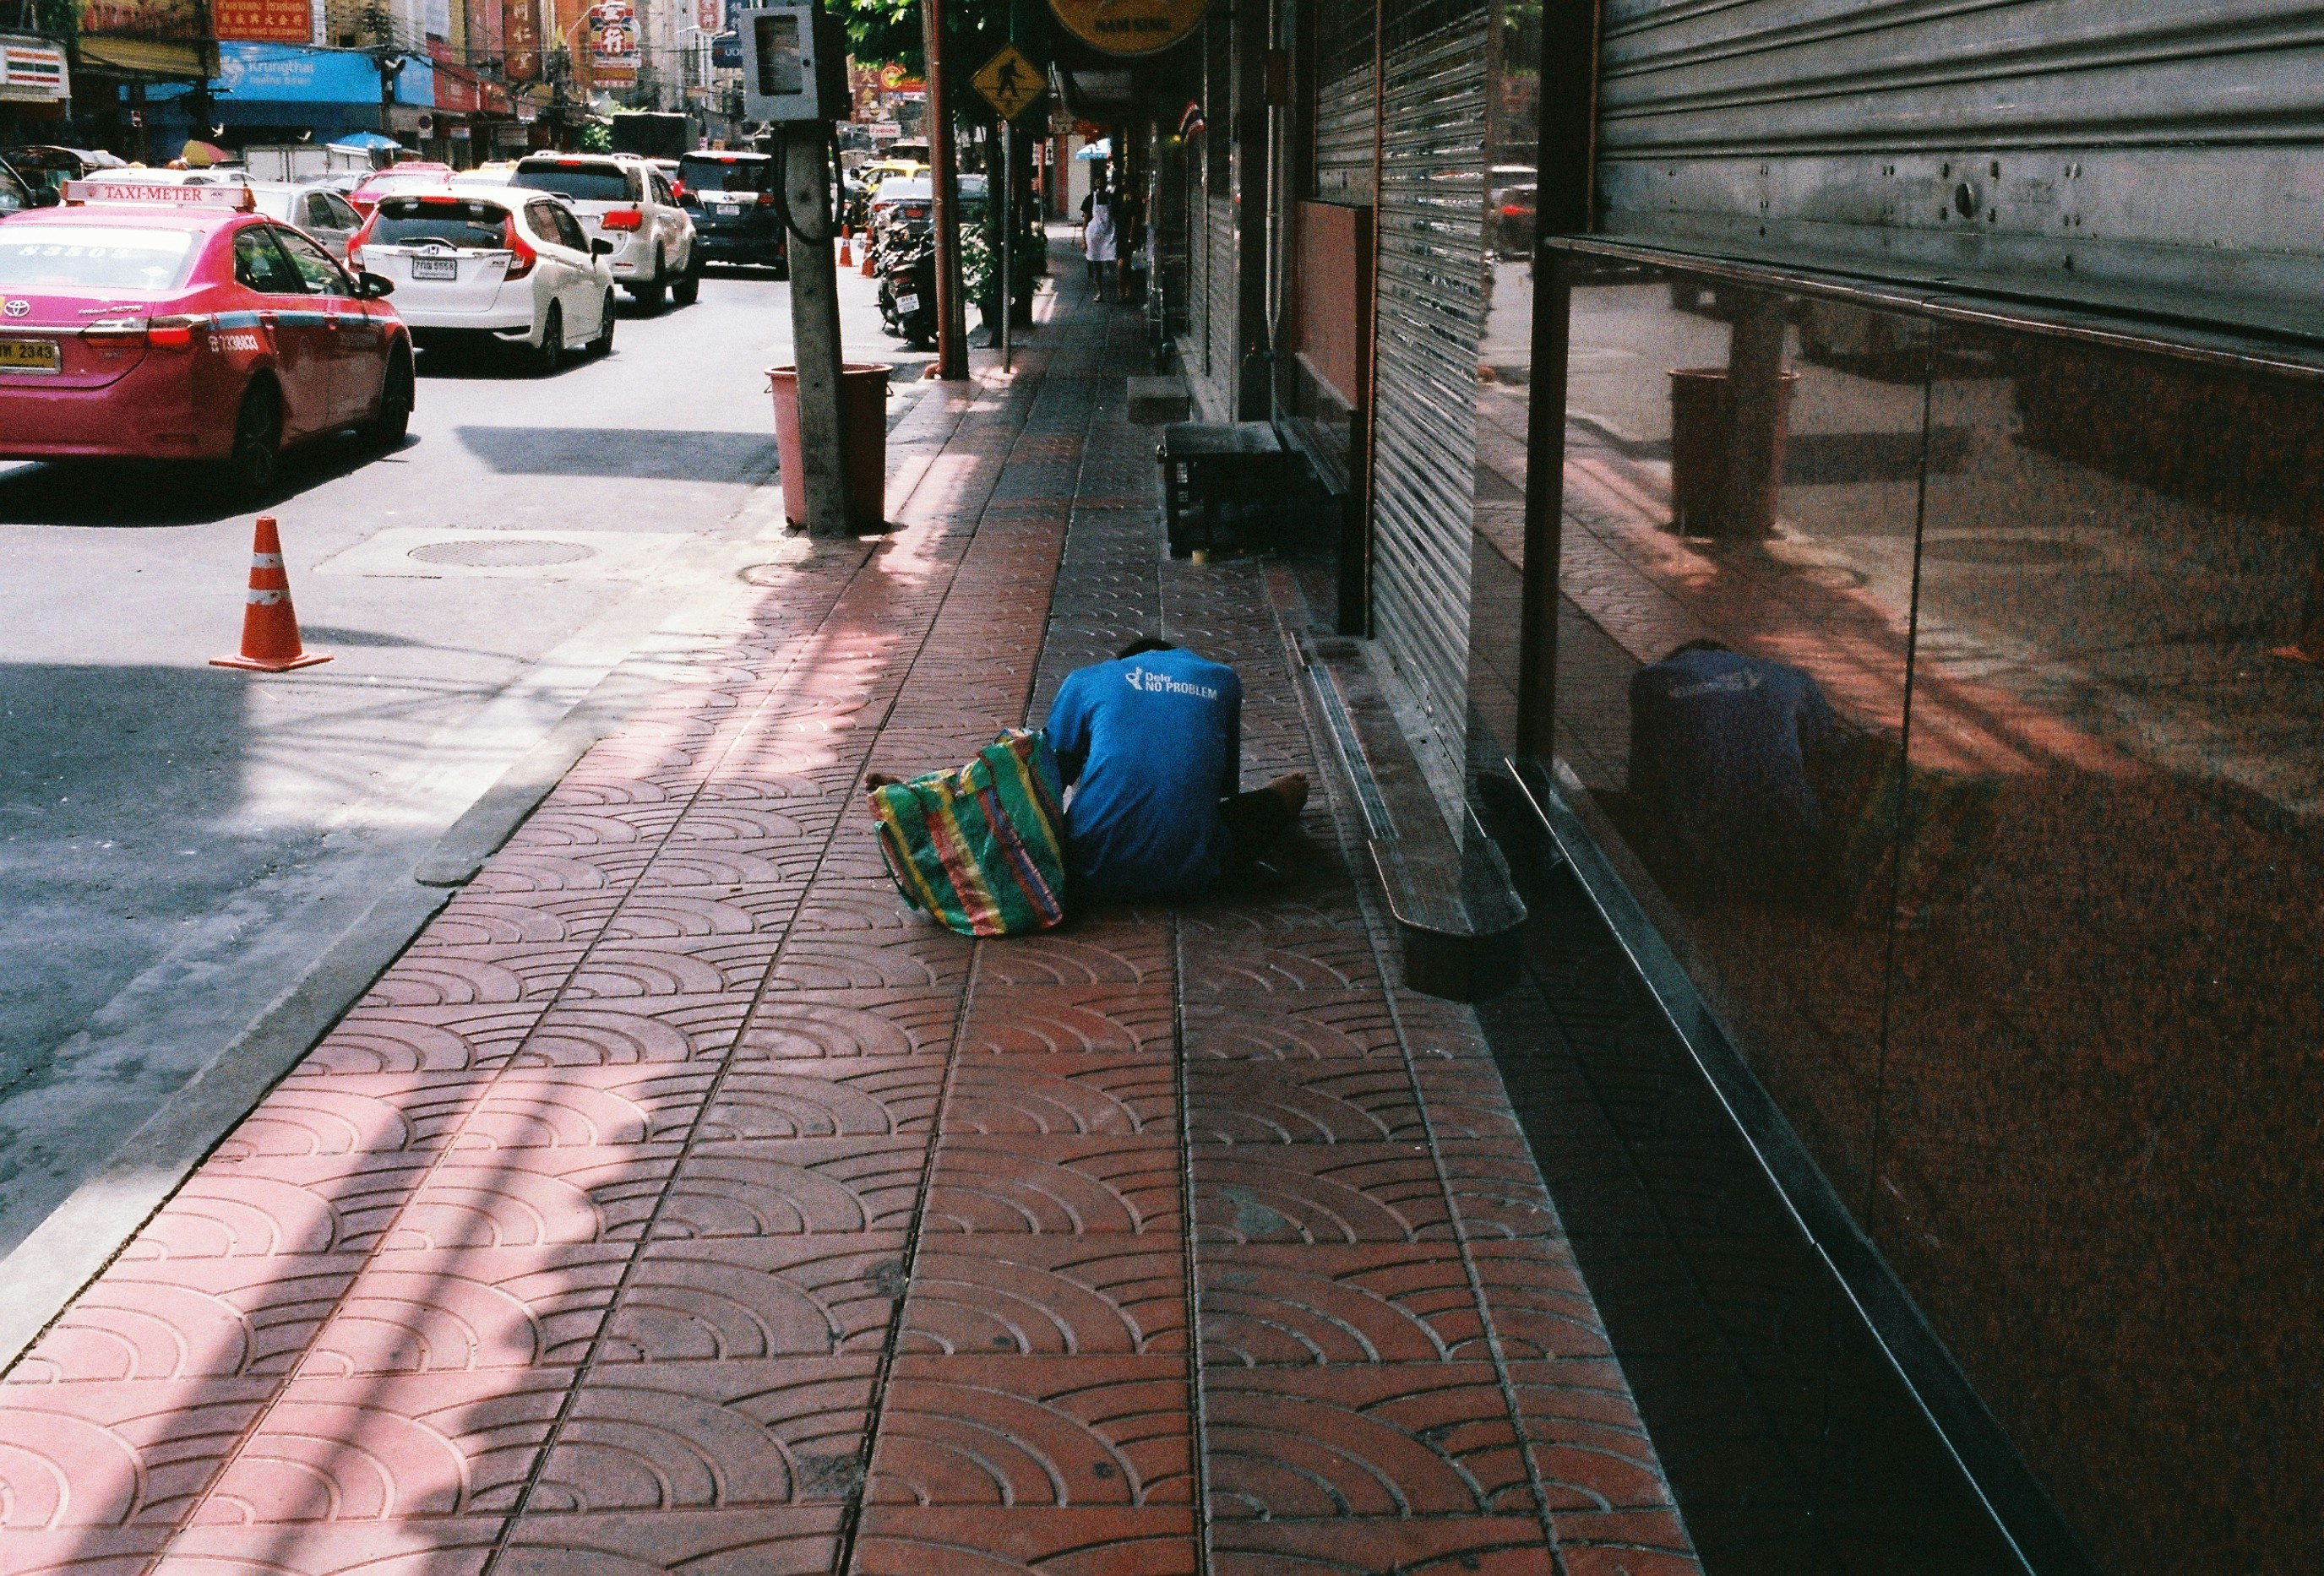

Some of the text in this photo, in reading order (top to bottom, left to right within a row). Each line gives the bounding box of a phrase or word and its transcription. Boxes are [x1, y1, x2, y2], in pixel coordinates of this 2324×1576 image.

[248, 62, 313, 76] Krungthai
[105, 186, 203, 202] TAXI-METER
[1146, 672, 1171, 683] Delo
[1146, 682, 1217, 699] NO PROBLEM
